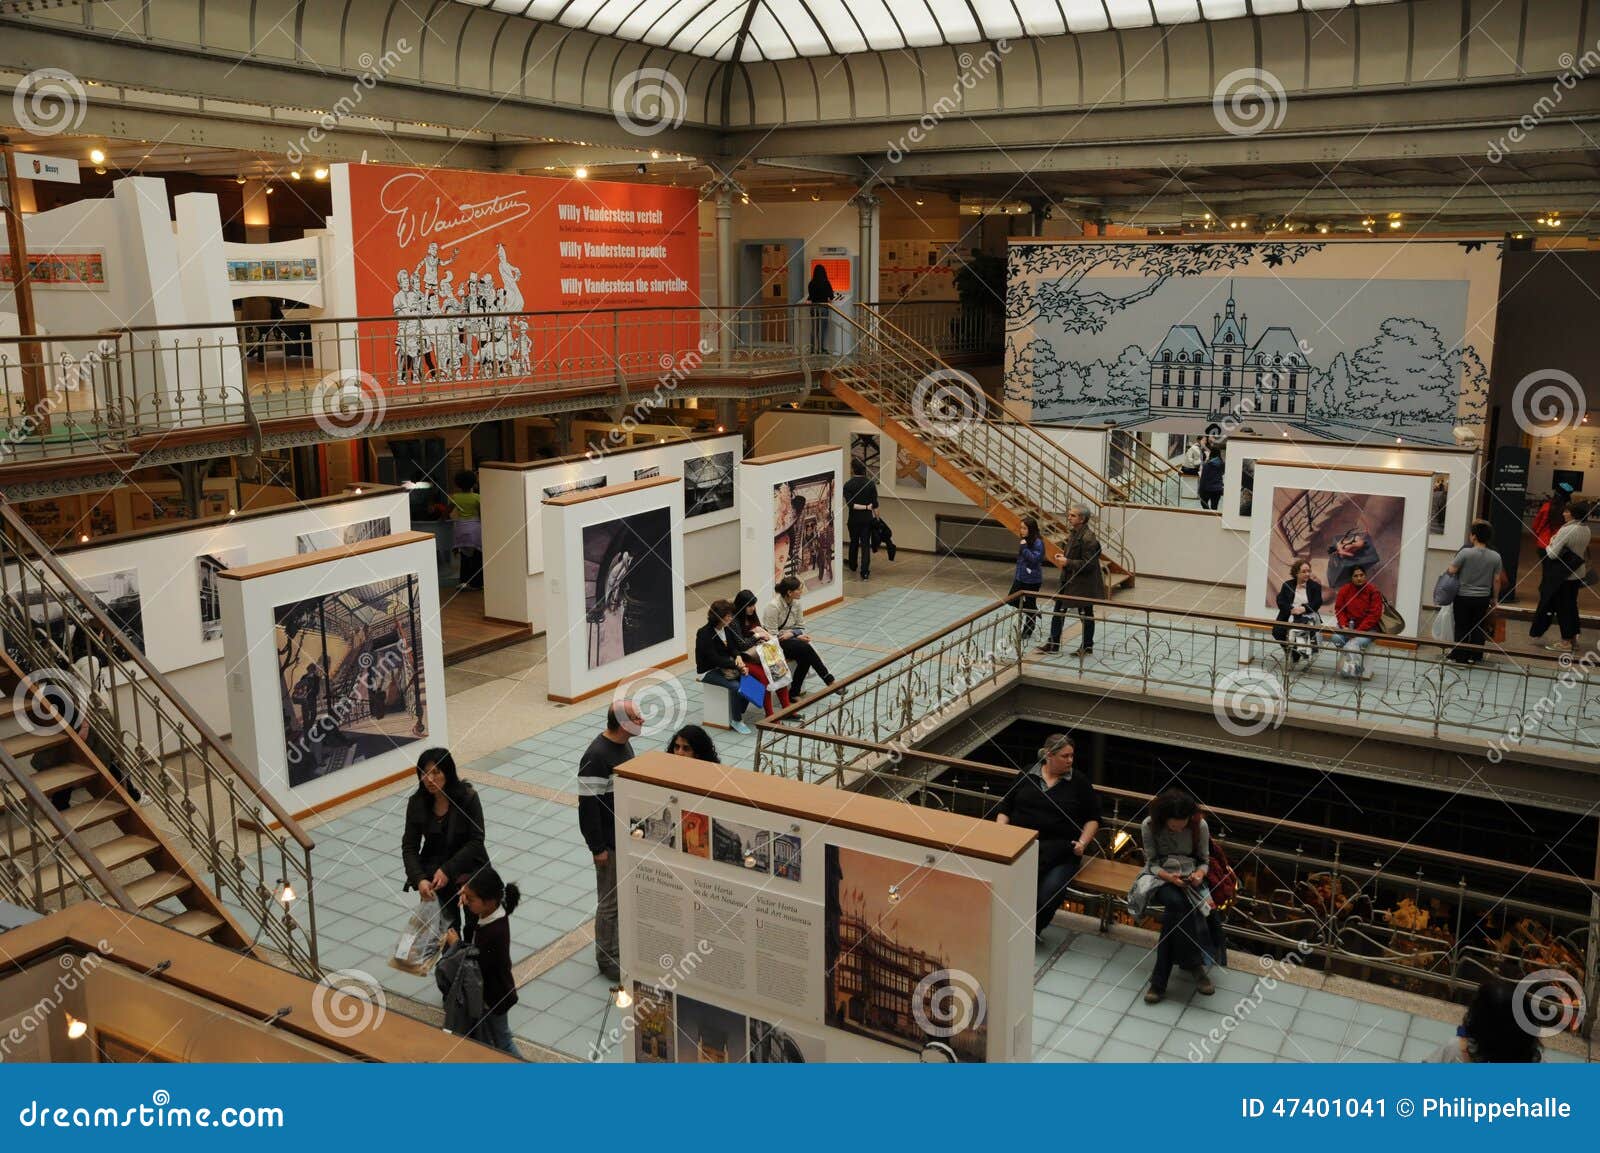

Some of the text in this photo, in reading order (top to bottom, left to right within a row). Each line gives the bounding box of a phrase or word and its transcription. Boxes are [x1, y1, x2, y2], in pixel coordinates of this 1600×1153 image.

[558, 204, 663, 224] Willy Vandersteen vertelt
[560, 241, 667, 260] Willy Vandersteen raconte
[561, 277, 689, 296] Willy Vandersteen the storyteller
